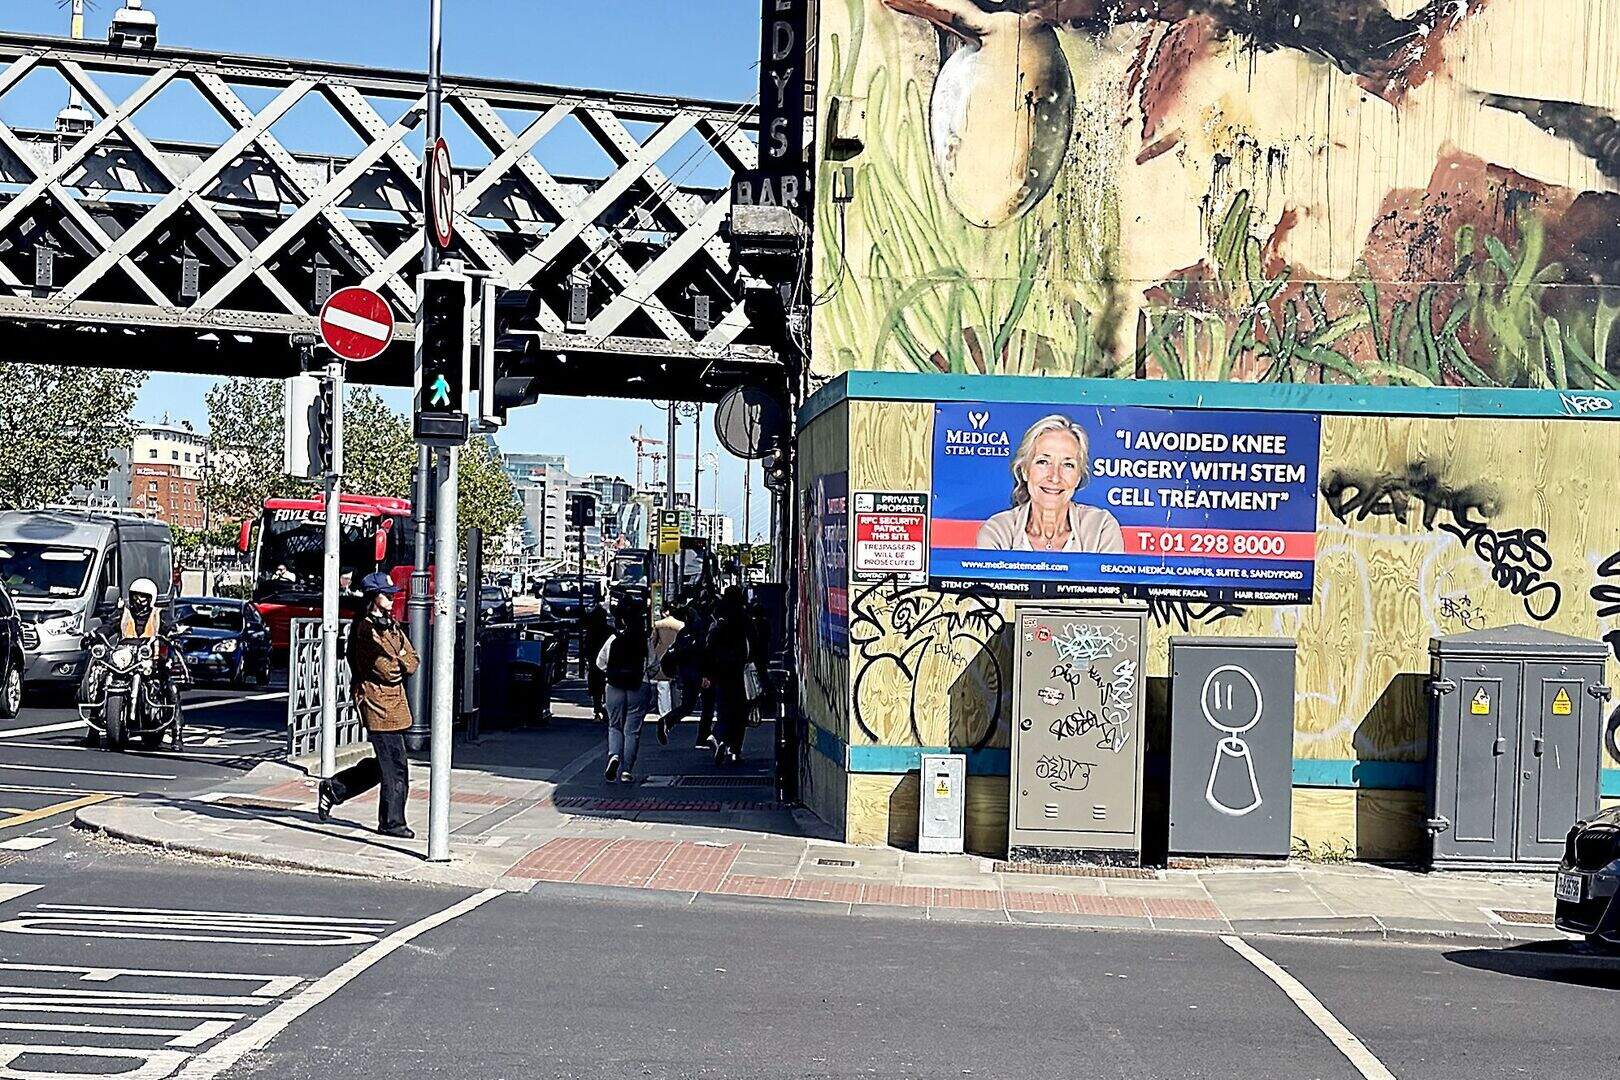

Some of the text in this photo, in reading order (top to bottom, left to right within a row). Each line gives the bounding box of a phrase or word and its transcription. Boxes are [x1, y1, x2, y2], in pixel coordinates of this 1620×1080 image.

[768, 0, 795, 158] DYS
[736, 175, 800, 208] BAR
[946, 429, 1010, 445] MEDICA
[1134, 432, 1229, 452] AVOIDED
[1232, 434, 1287, 454] KNEE
[945, 445, 1010, 457] STEM CELLS
[1093, 458, 1306, 483] SURGERY WITH STEM
[881, 495, 920, 504] PRIVATE
[1106, 487, 1154, 507] CELL
[876, 504, 925, 513] PROPERTY
[274, 509, 309, 522] FOYLE
[879, 517, 921, 526] SECURITY
[873, 525, 907, 533] PATROL
[871, 532, 910, 541] THIS SITE
[864, 543, 917, 551] TRESPASSERS
[1137, 533, 1286, 555] T: 01 298 8000
[960, 560, 1069, 572] www.medicastemcells.com
[1101, 564, 1136, 574] BEACON
[1138, 566, 1176, 576] MEDICAL
[1176, 567, 1215, 578] CAMPUS,
[1215, 568, 1240, 578] SUITE
[1250, 569, 1304, 580] SANDYFORD
[941, 580, 962, 589] STEM
[1098, 586, 1121, 595] DRIPS
[1147, 588, 1209, 598] VAMPIRE FACIAL
[1234, 590, 1299, 601] HAIR REGROWTH
